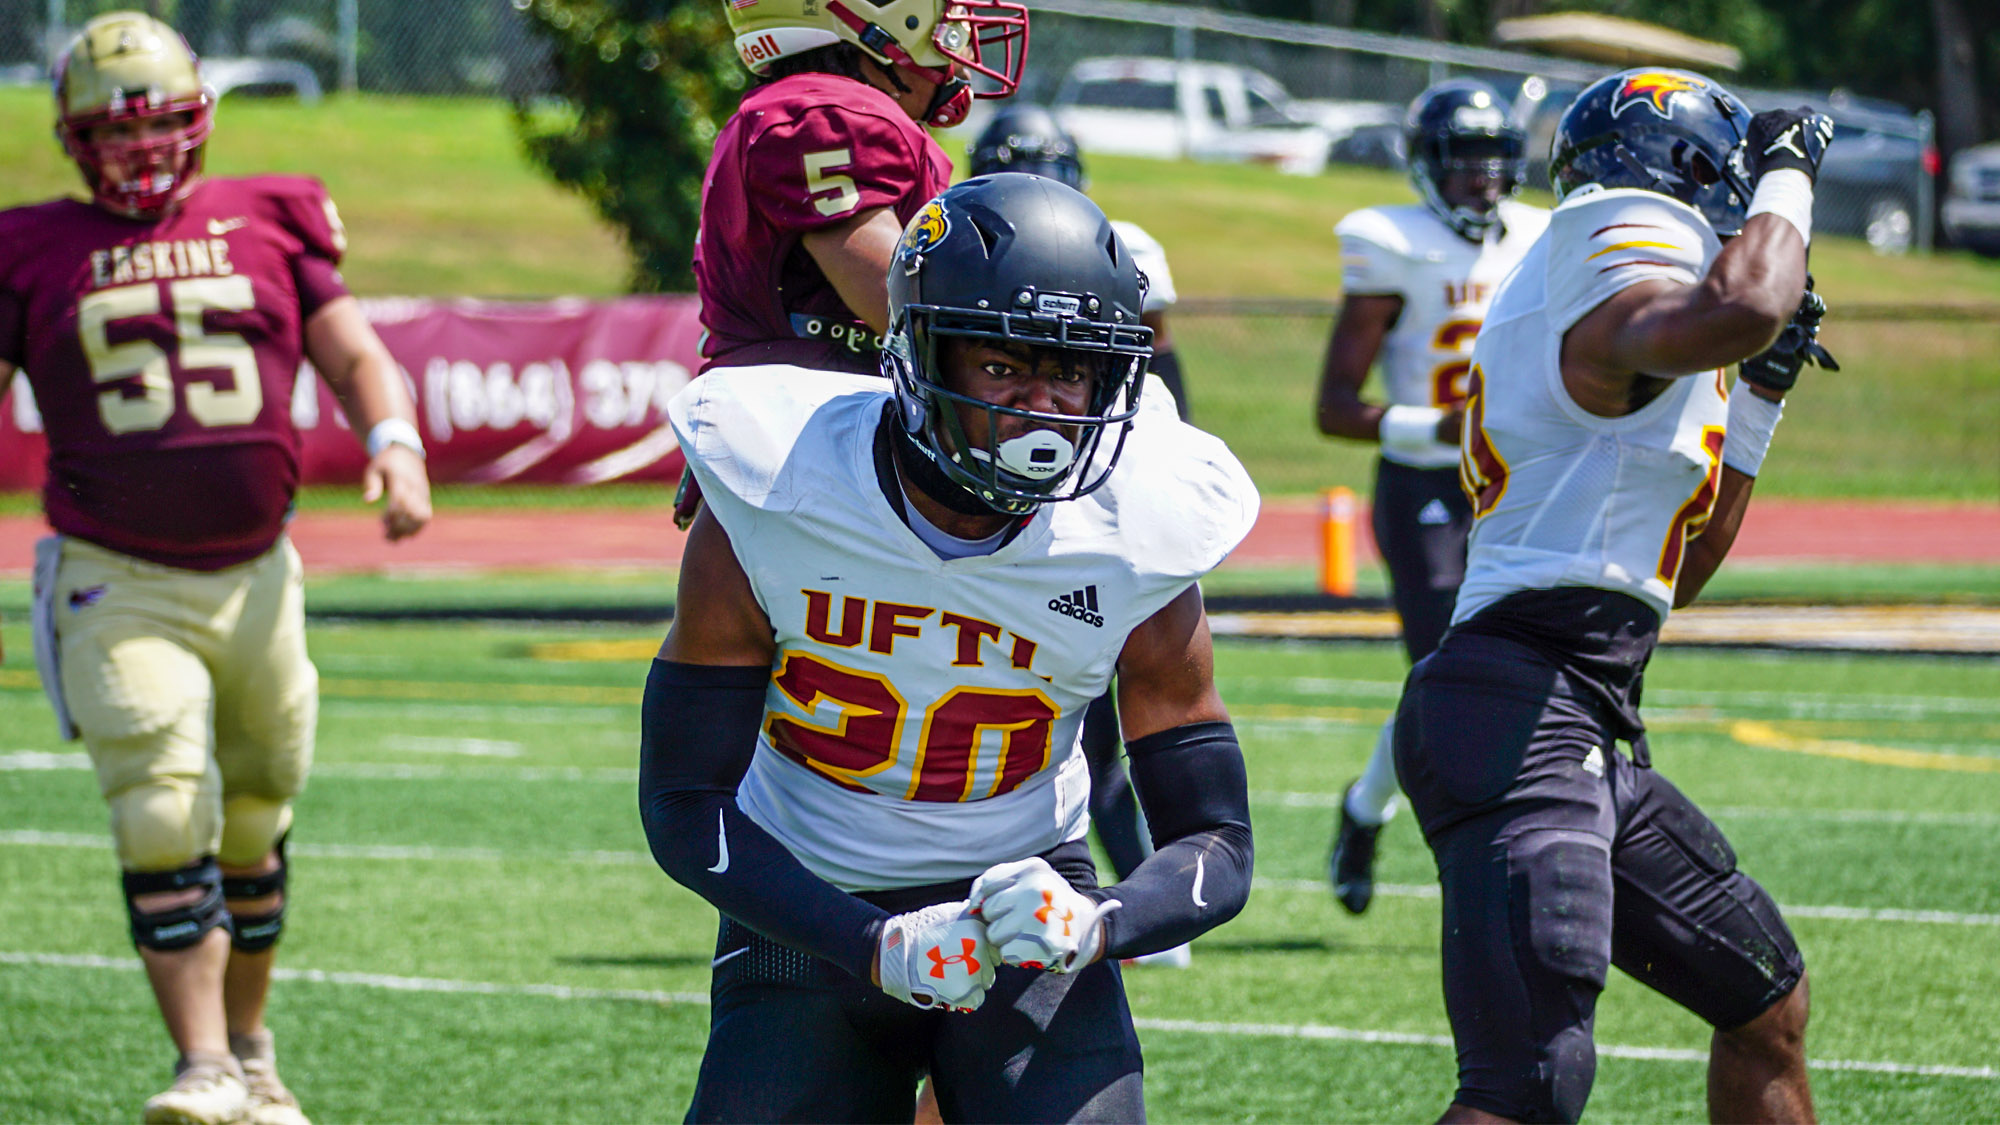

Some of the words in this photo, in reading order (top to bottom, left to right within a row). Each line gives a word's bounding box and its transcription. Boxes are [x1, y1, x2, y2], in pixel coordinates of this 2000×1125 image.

[803, 149, 860, 217] 5
[91, 239, 233, 287] ERSKINE
[78, 275, 263, 435] 55
[423, 356, 574, 443] (864)
[1047, 599, 1104, 628] adidas
[762, 649, 1063, 803] 20
